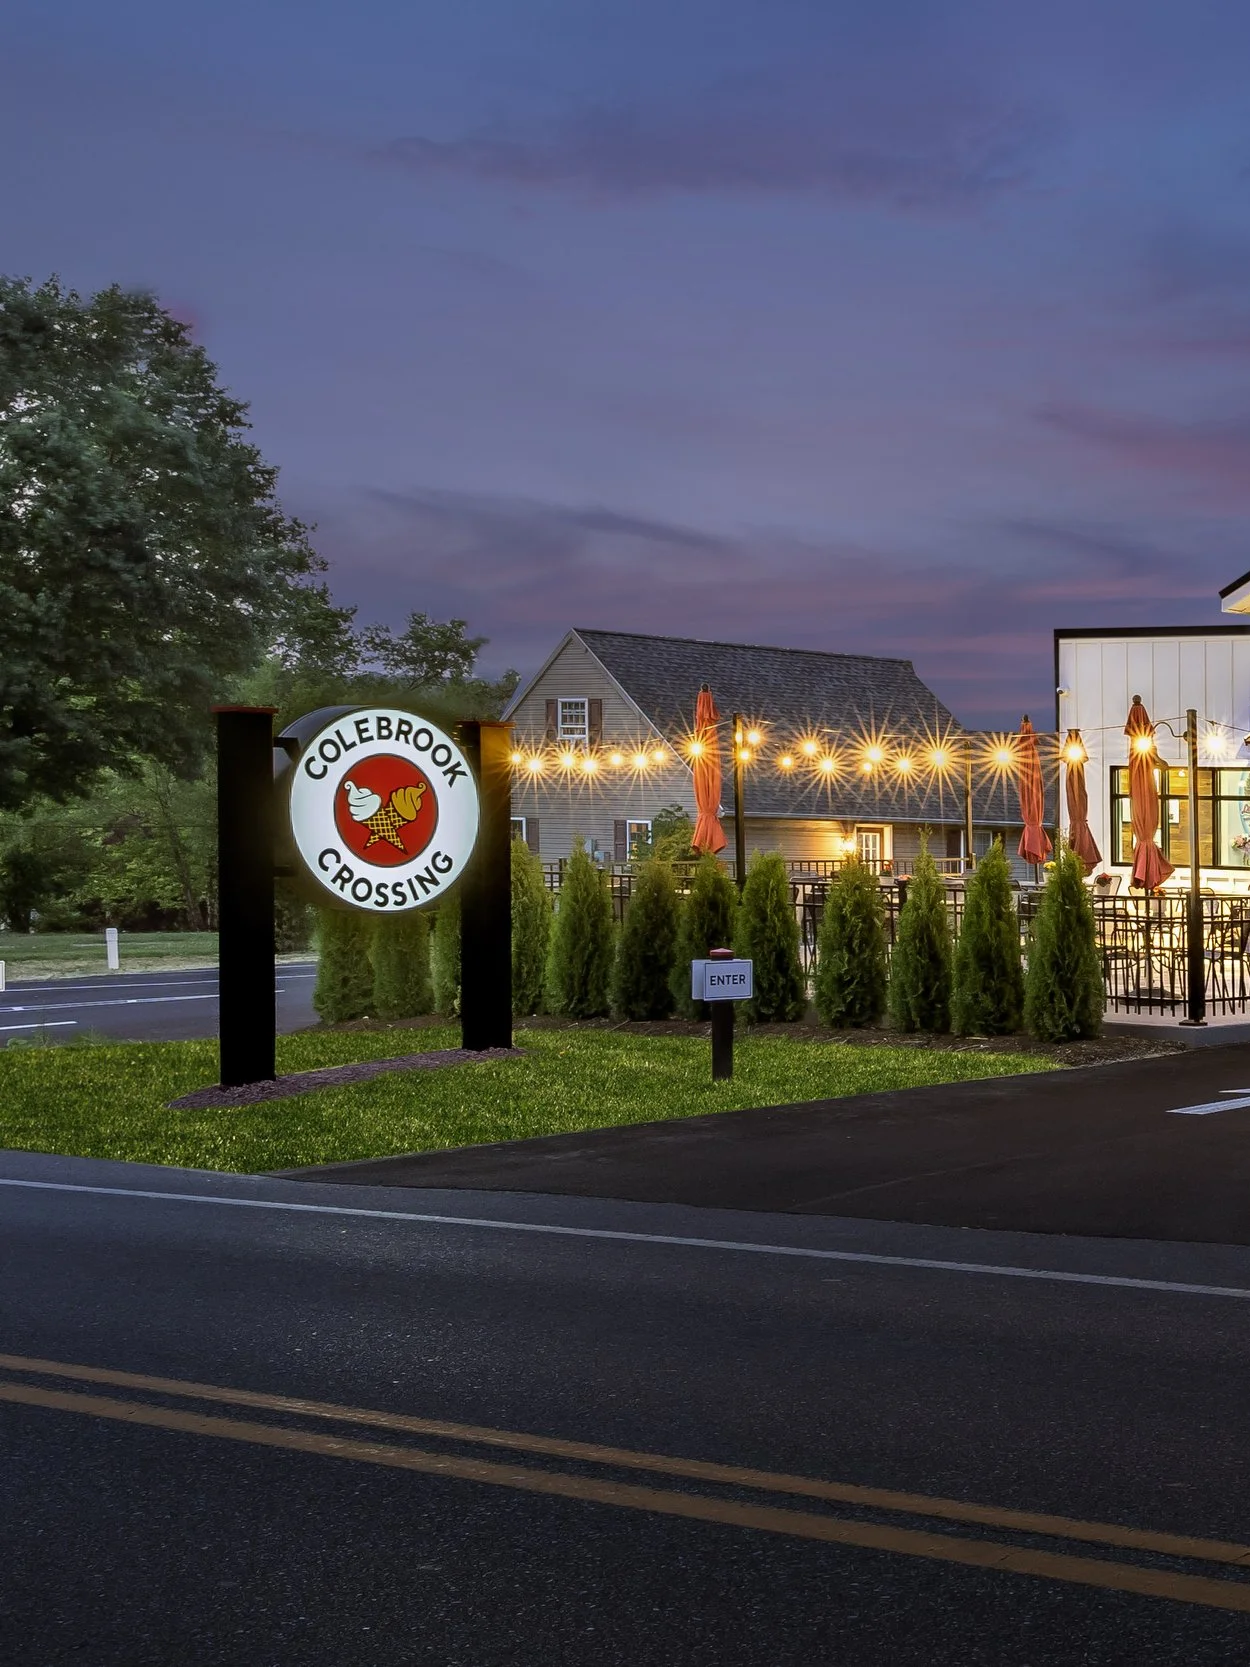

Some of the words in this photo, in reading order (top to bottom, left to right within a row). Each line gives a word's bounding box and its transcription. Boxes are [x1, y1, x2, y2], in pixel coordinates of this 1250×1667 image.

[305, 716, 468, 788] COLEBROOK
[318, 848, 453, 908] CROSSING
[709, 974, 746, 986] ENTER
